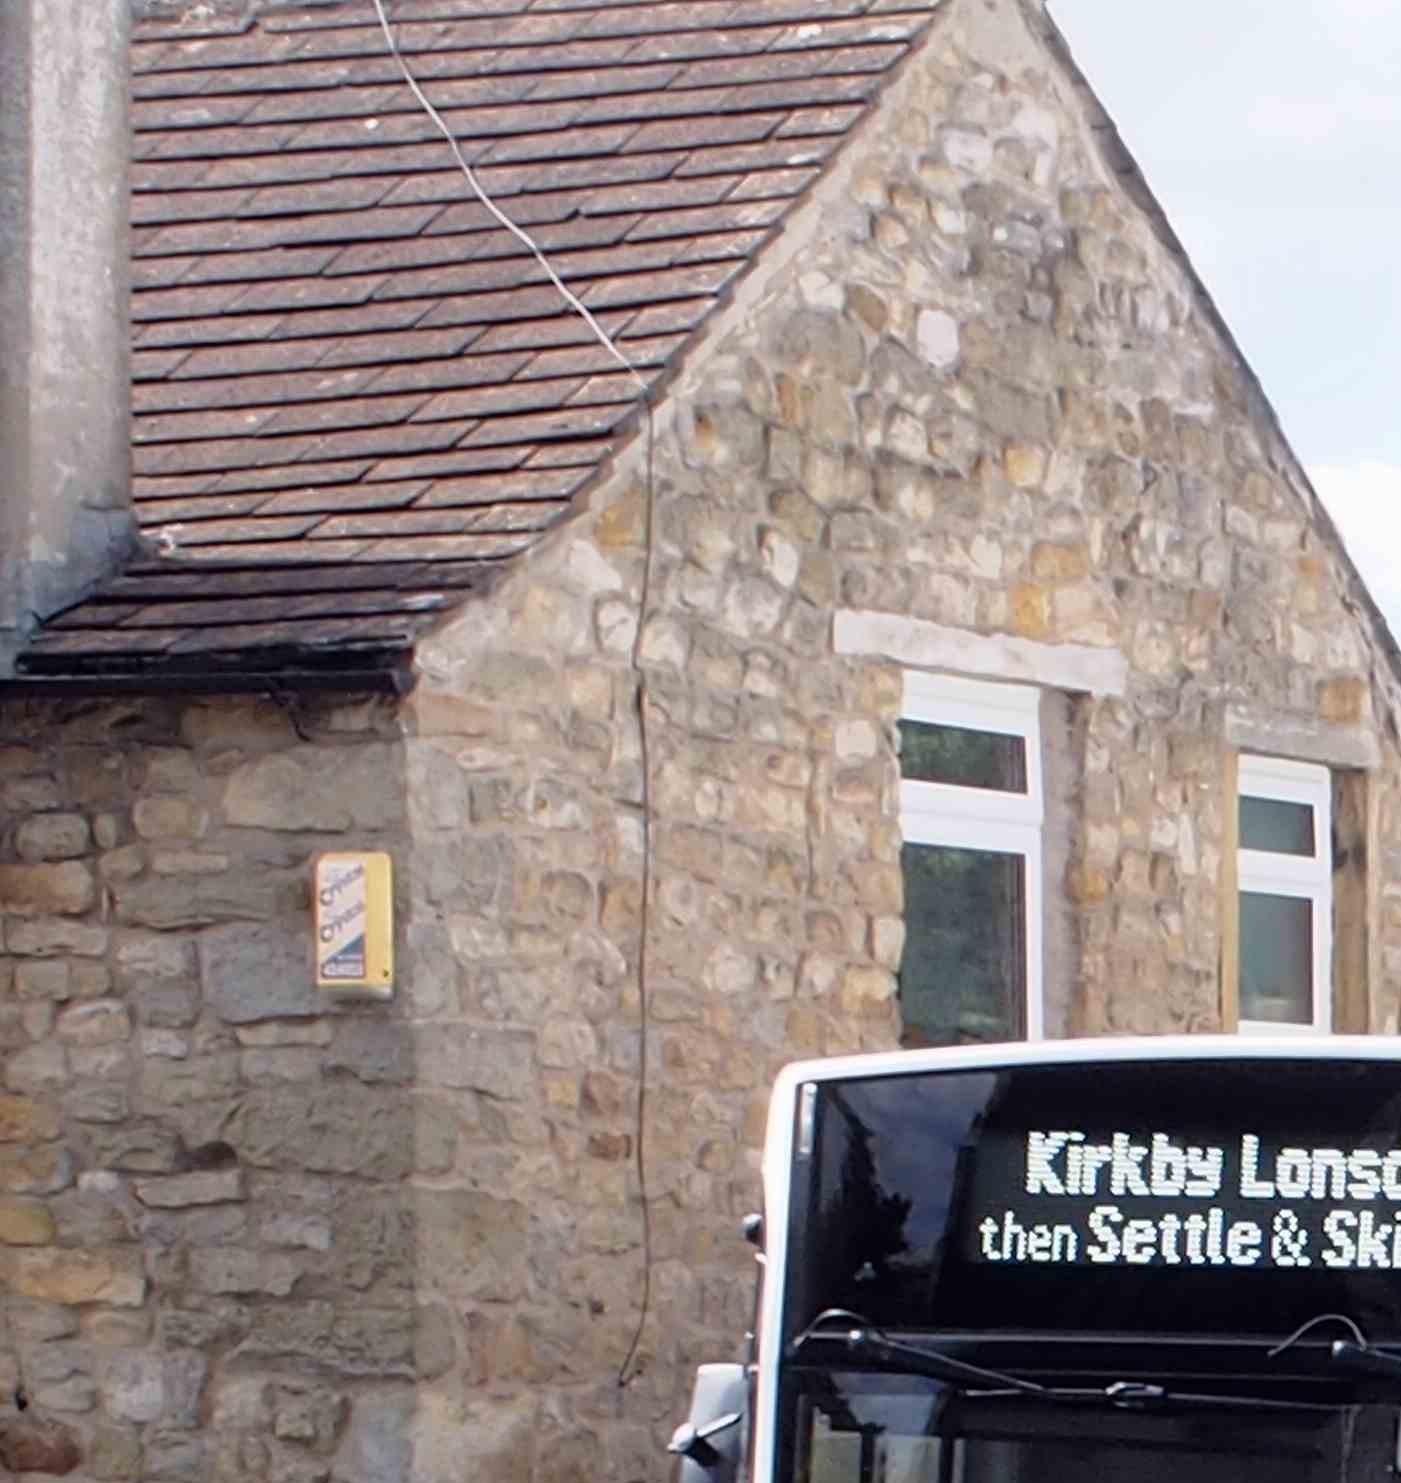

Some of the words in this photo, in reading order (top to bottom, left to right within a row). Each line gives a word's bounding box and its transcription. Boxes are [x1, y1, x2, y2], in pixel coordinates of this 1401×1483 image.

[1026, 1131, 1223, 1196] Kirkby
[980, 1210, 1078, 1261] then
[1087, 1205, 1263, 1265] Settle
[1271, 1208, 1311, 1266] &
